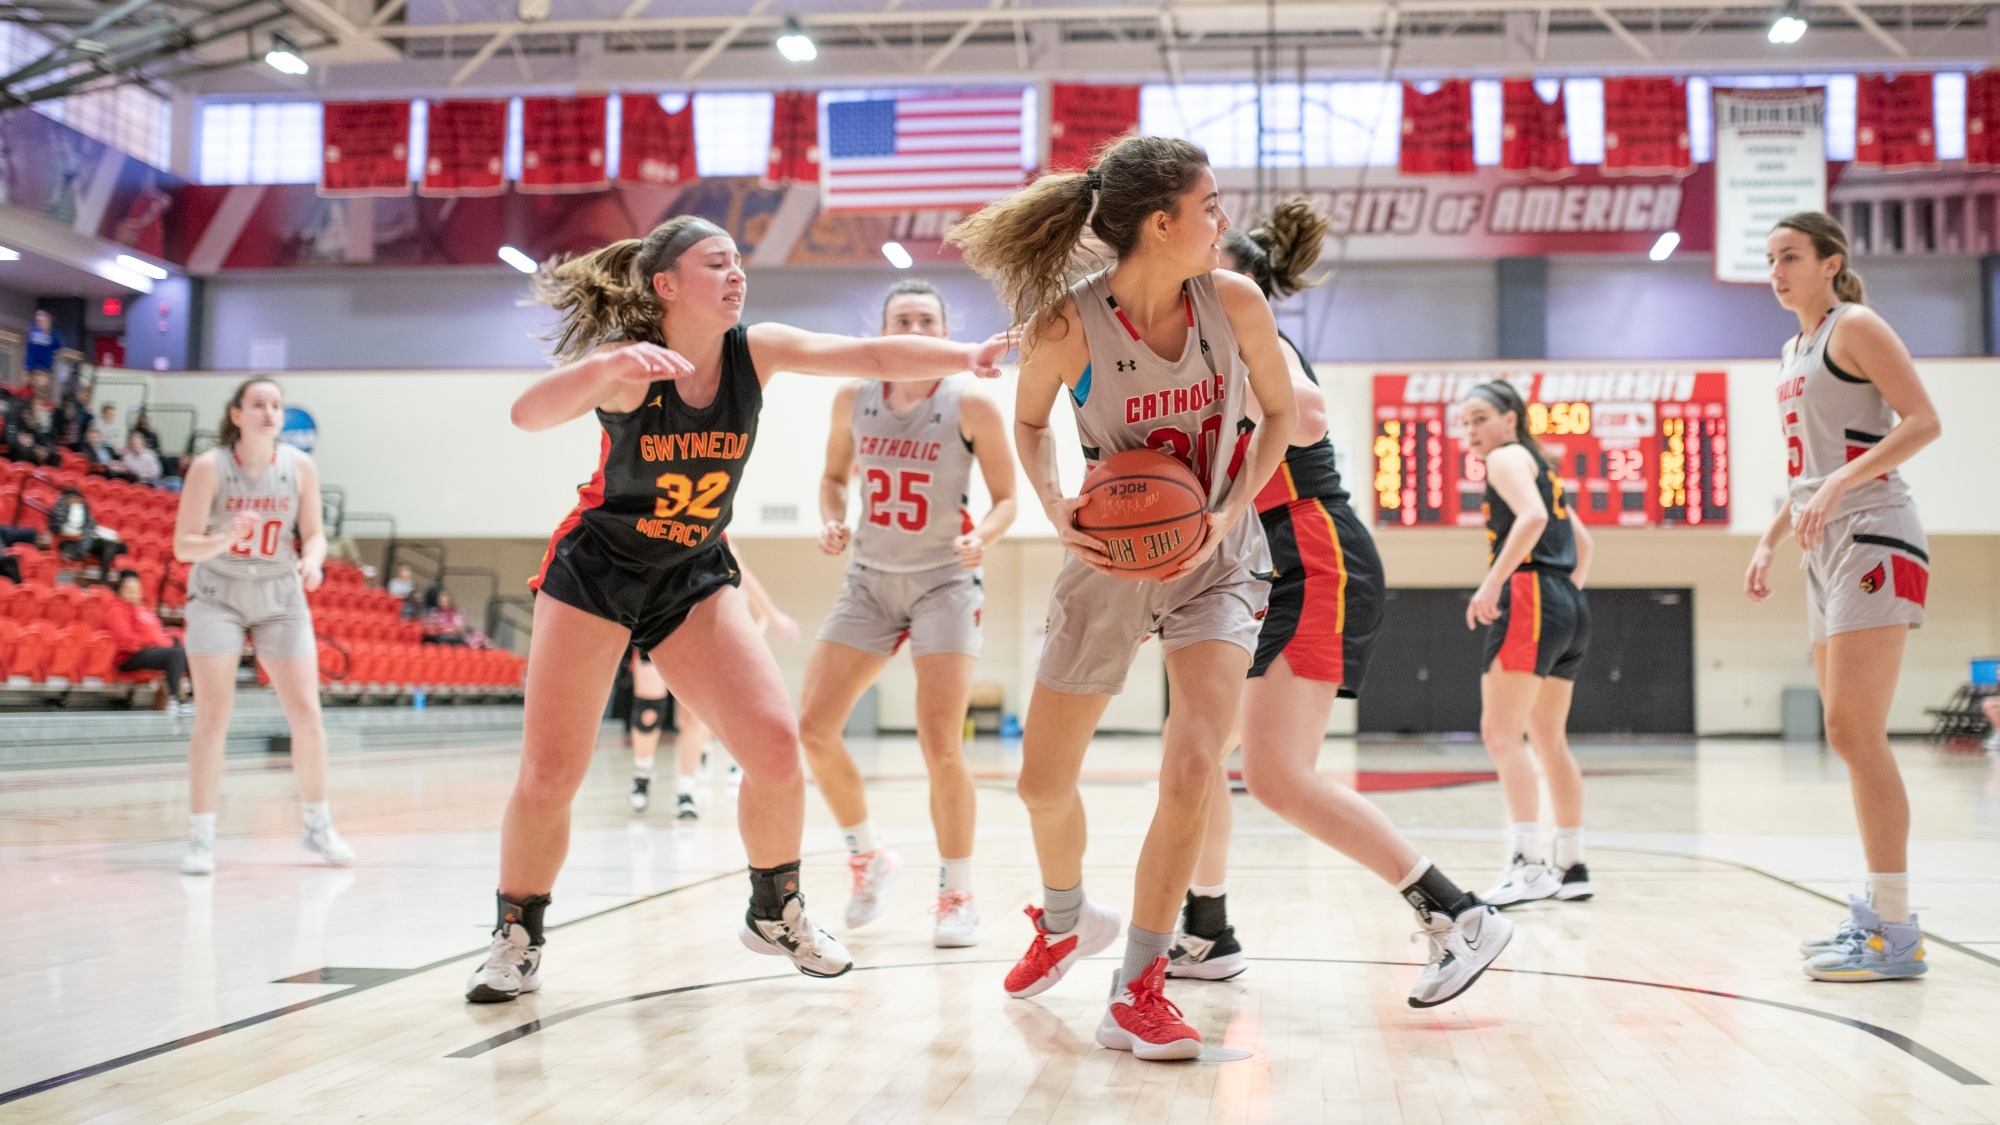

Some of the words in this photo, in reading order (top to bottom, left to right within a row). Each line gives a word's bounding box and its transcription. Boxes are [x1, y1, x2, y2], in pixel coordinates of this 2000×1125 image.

[1432, 192, 1482, 234] OF
[1488, 185, 1683, 234] AMERICA
[640, 431, 749, 462] GWYNEDD
[860, 436, 942, 462] CATHOLIC
[1606, 449, 1644, 481] 32
[654, 470, 730, 520] 32
[866, 468, 933, 533] 25
[1109, 482, 1147, 496] ROCK
[636, 517, 714, 548] MERCY
[1143, 527, 1184, 561] THE
[1106, 538, 1137, 563] RO
